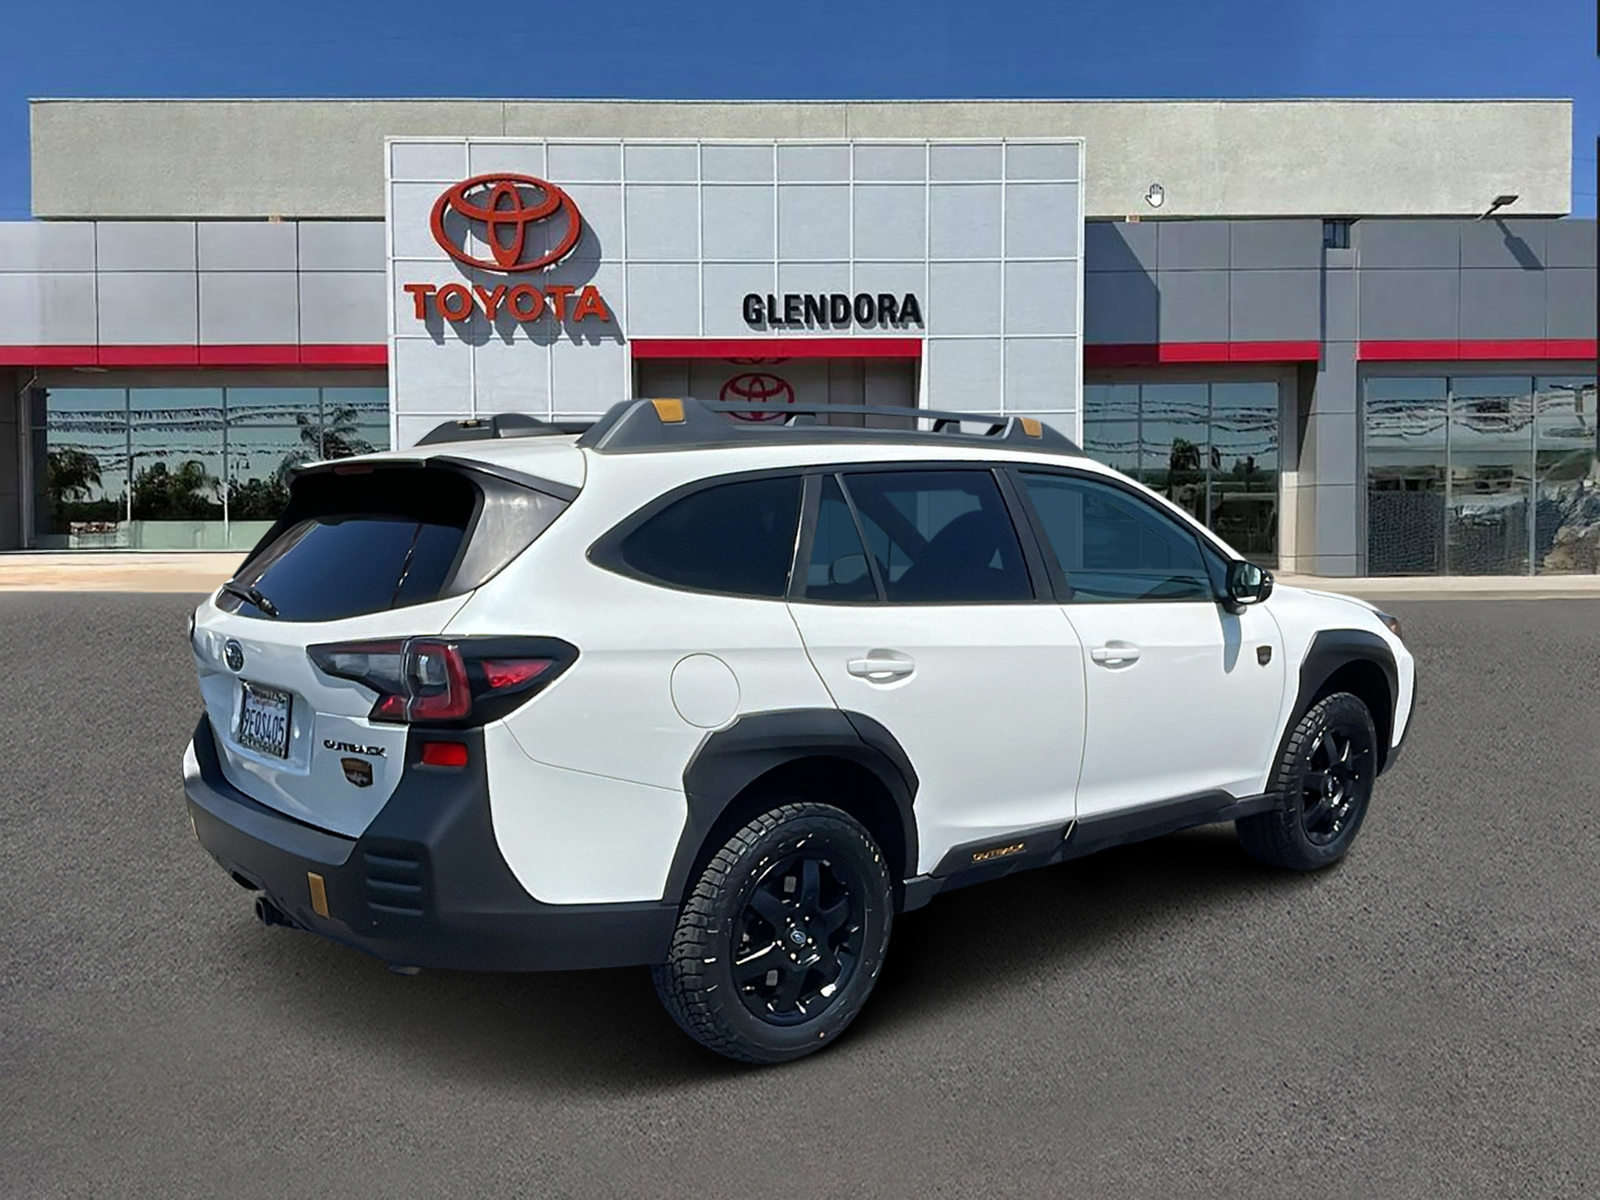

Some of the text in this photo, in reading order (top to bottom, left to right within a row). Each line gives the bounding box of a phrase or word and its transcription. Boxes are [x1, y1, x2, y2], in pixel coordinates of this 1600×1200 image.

[404, 283, 610, 322] TOYOTA
[743, 293, 922, 324] GLENDORA
[323, 740, 388, 759] OUTBACK
